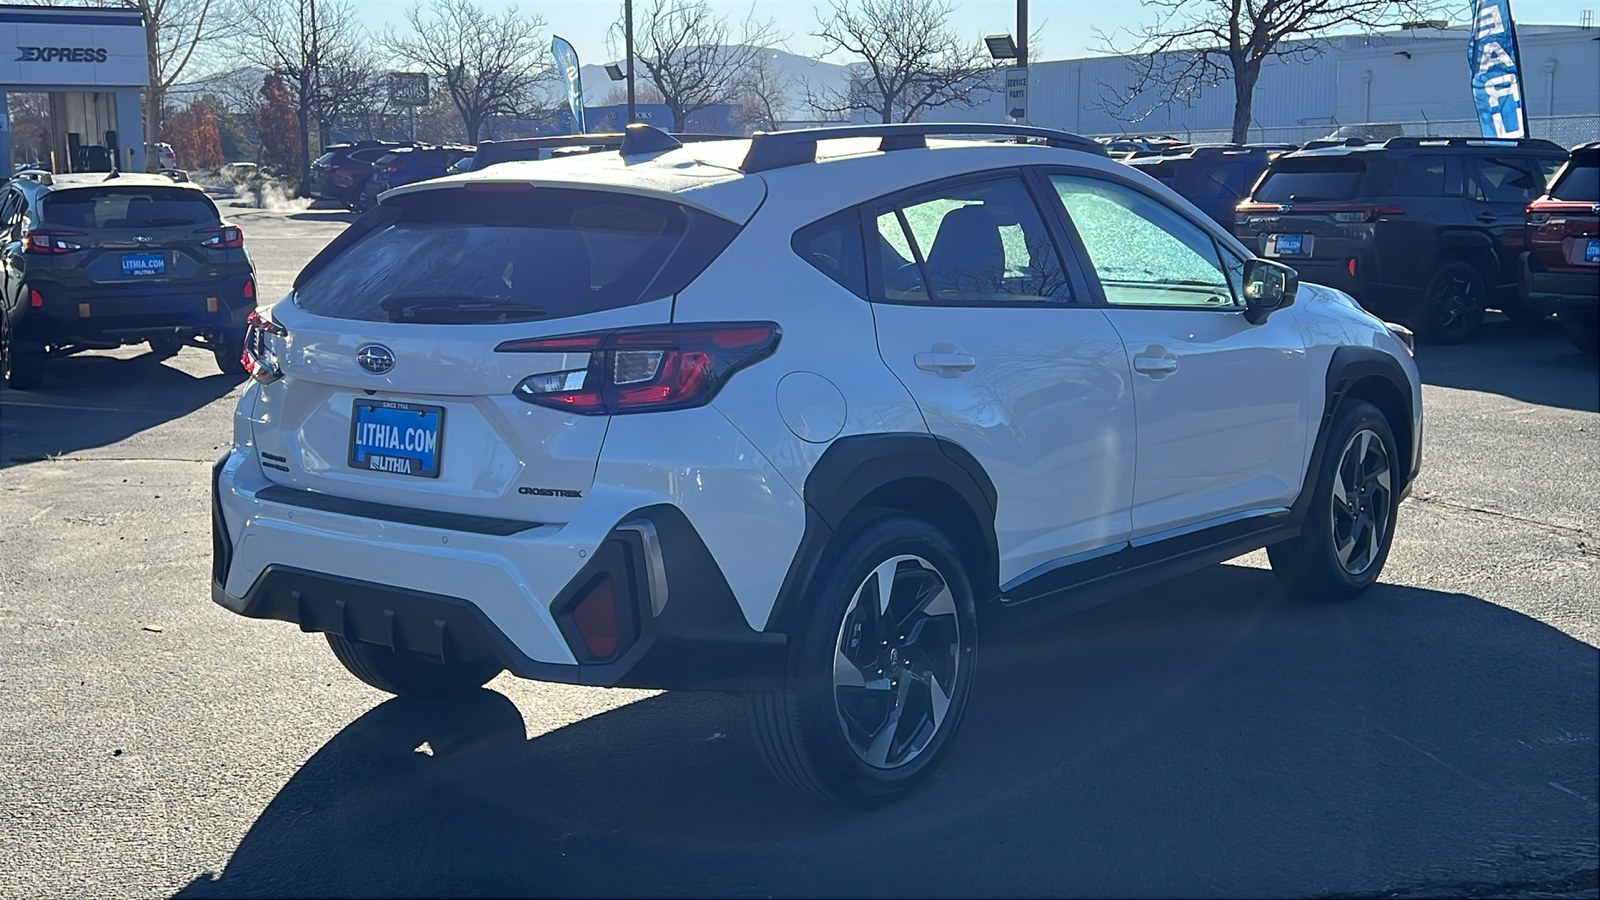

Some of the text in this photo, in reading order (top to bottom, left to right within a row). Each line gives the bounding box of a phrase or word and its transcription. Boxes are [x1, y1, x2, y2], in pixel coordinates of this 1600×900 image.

[14, 46, 107, 63] EXPRESS
[1007, 78, 1026, 87] SERVICE
[1009, 90, 1024, 98] PARTS
[122, 259, 165, 269] LITHIA.COM
[355, 421, 437, 454] LITHIA.COM
[380, 456, 411, 474] LITHIA
[518, 486, 583, 498] CROSSTREK
